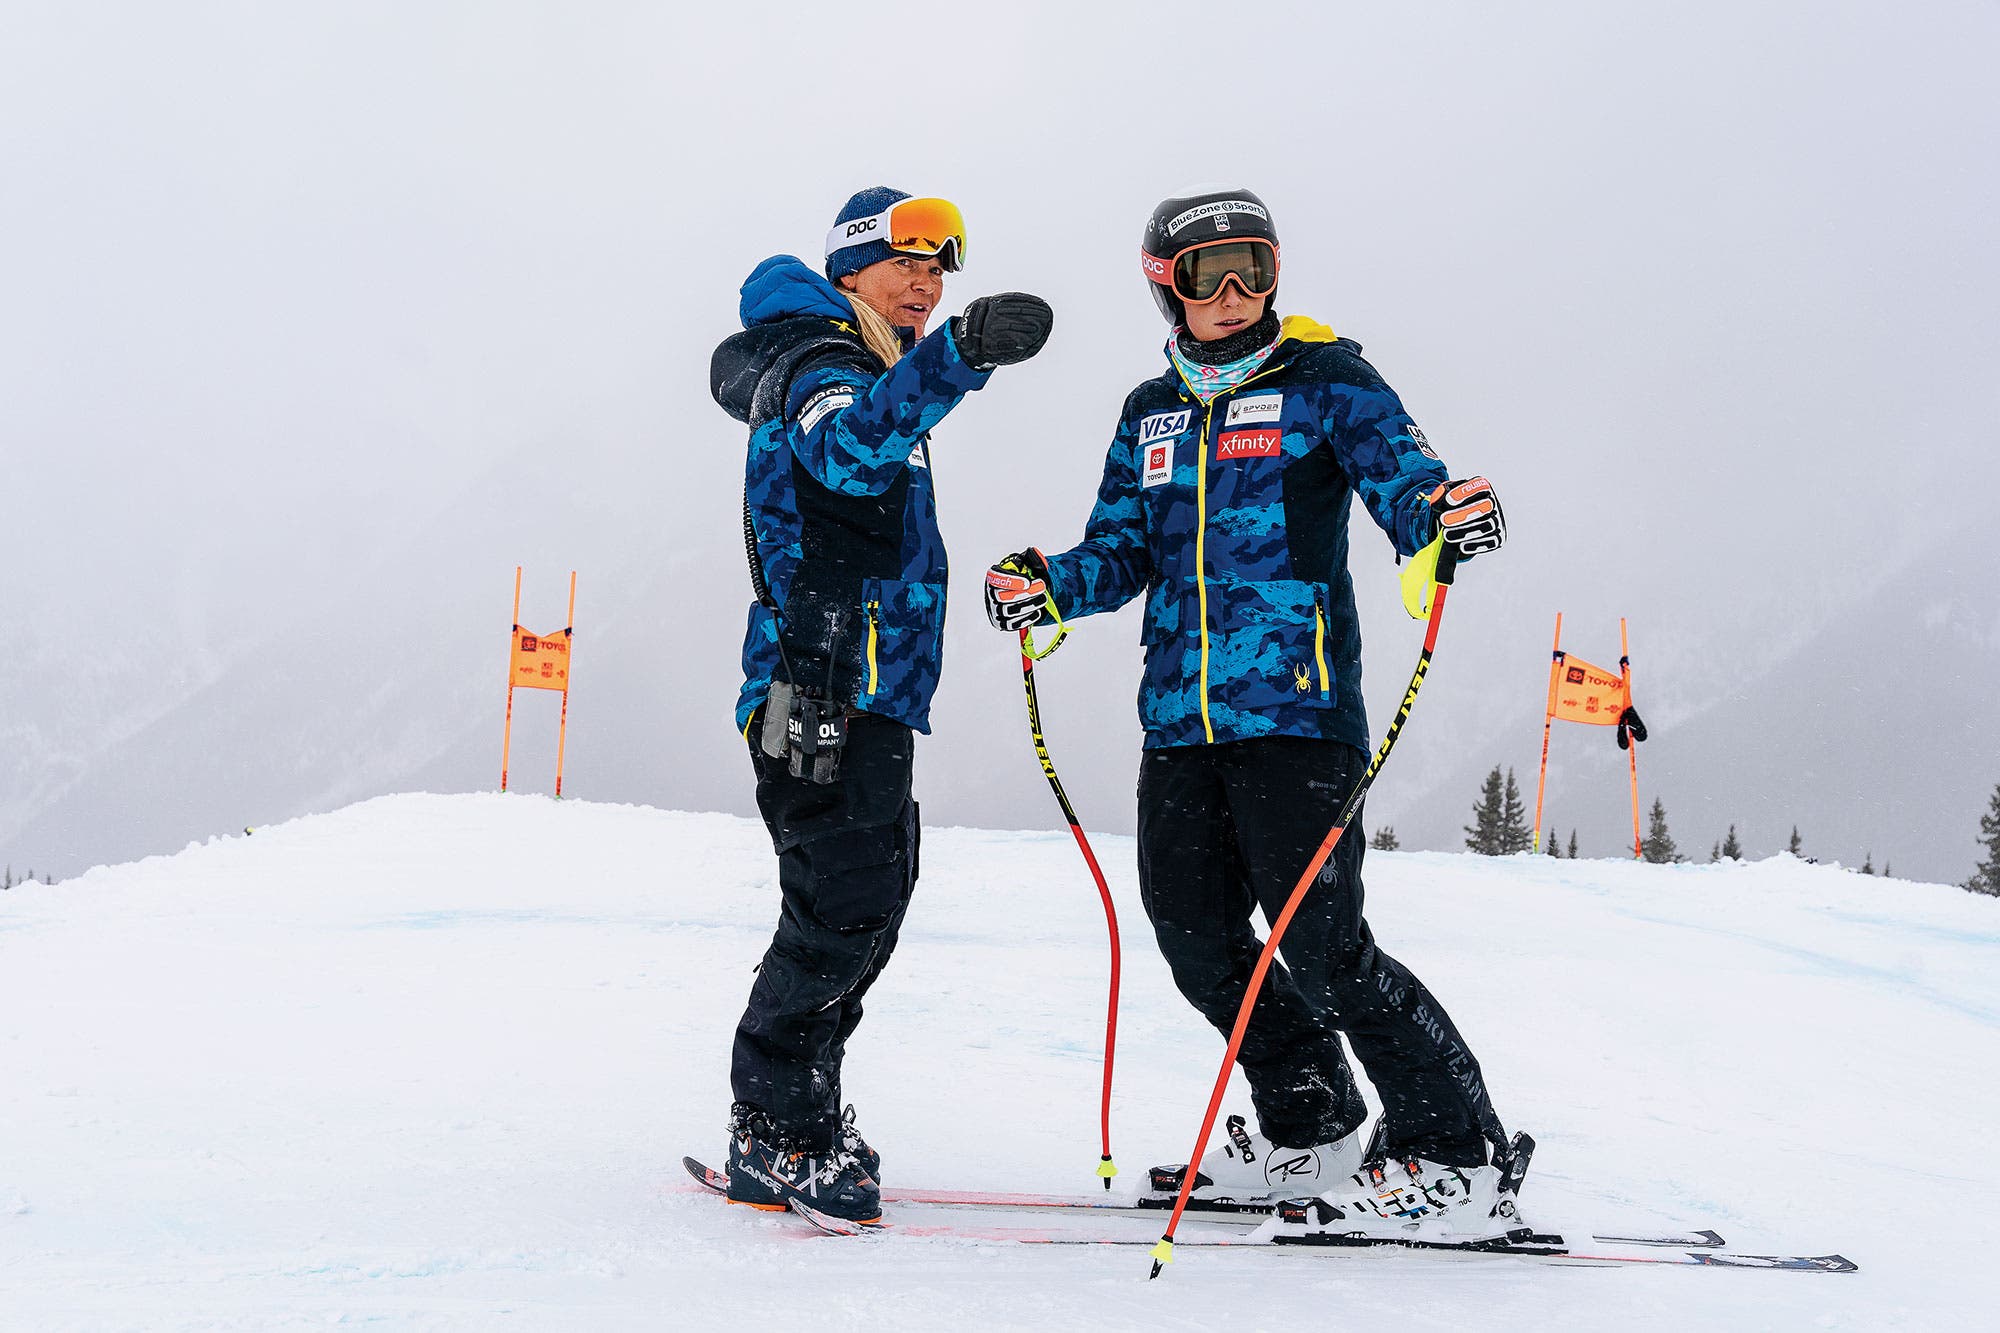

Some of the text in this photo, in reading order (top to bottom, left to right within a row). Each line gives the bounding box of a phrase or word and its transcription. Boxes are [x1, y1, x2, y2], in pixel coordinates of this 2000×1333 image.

[1170, 204, 1221, 231] BlueZone
[1233, 202, 1266, 217] Sports
[1243, 403, 1279, 411] SPYDER
[1142, 414, 1186, 439] VISA
[1221, 434, 1277, 455] xfinity
[1147, 472, 1168, 481] TOYOTA
[1400, 657, 1430, 719] LEKI
[1032, 733, 1057, 778] LEKI
[1443, 1040, 1483, 1103] TEAM
[738, 1159, 783, 1195] LANGE
